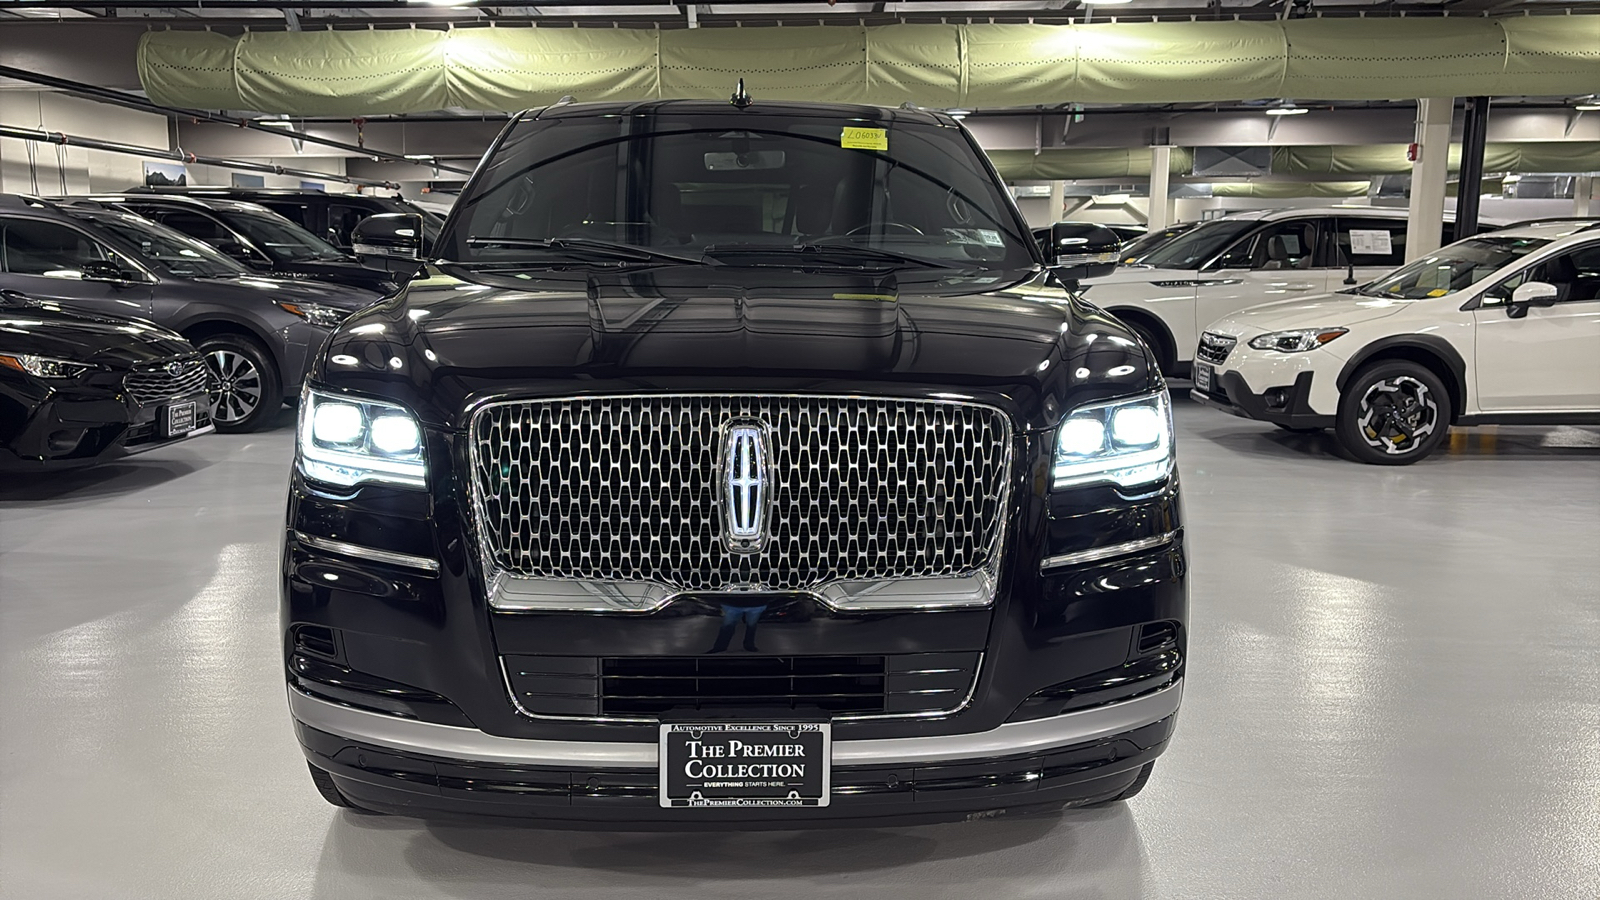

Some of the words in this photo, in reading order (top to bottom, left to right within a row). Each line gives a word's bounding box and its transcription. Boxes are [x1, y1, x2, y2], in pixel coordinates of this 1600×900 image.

[685, 741, 725, 758] THE
[728, 740, 806, 758] PREMIER
[684, 760, 806, 779] COLLECTION
